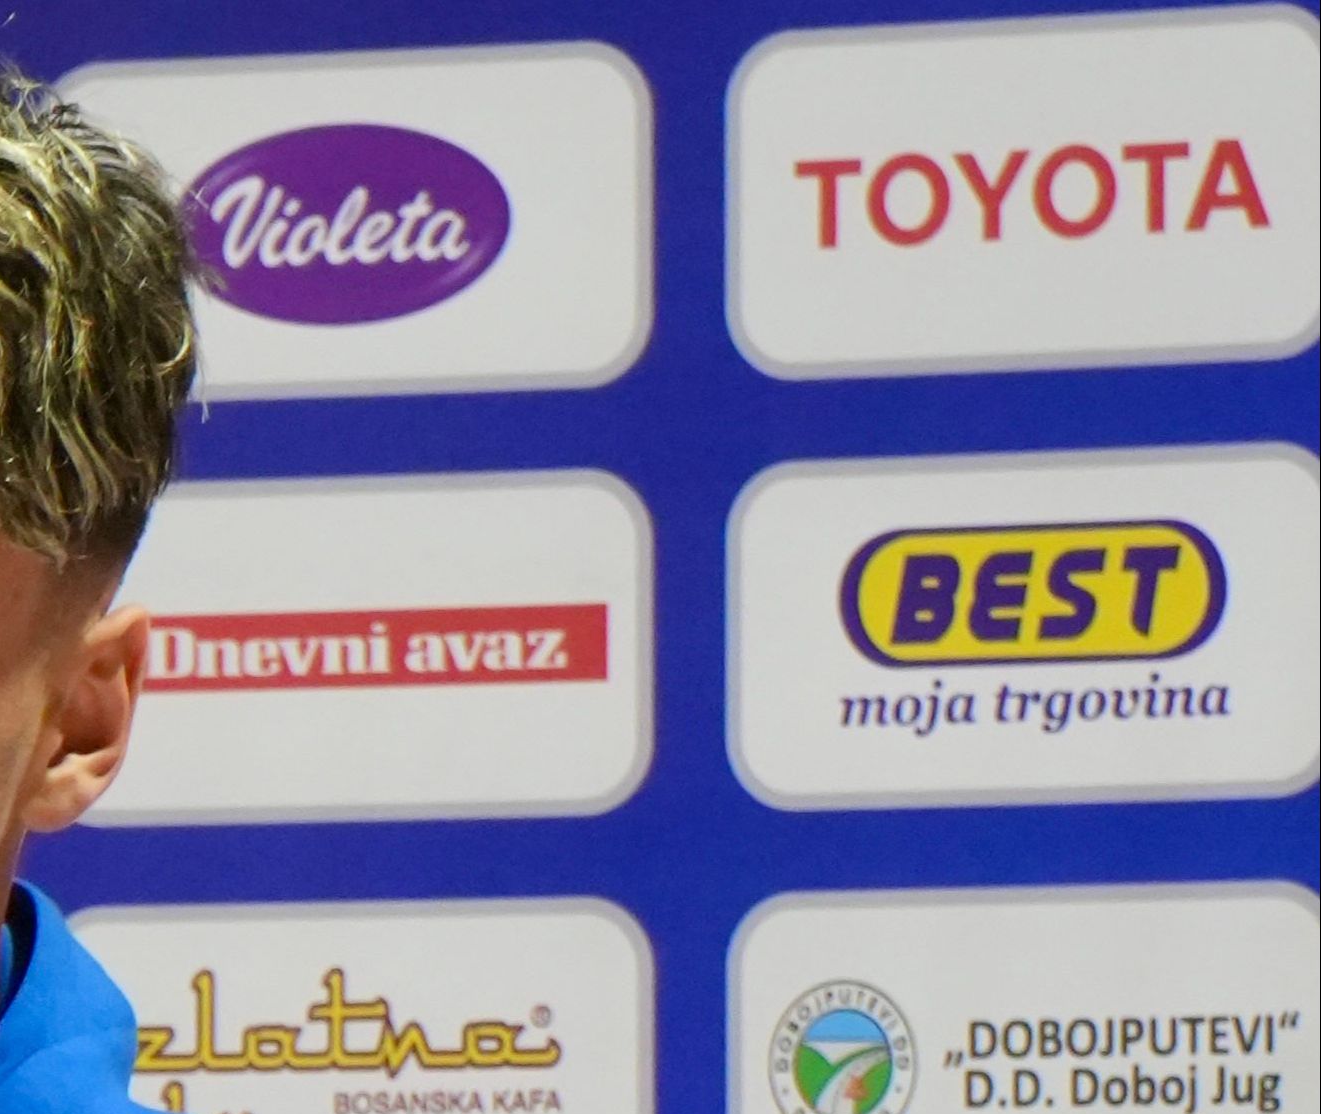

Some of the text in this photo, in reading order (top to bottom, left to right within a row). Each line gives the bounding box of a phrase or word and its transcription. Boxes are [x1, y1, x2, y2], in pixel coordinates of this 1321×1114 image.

[211, 175, 470, 269] Violeta
[794, 138, 1272, 249] TOYOTA
[889, 543, 1182, 645] BEST
[147, 622, 569, 679] Dnevni avaz
[839, 672, 1231, 737] moja trgovina
[492, 1089, 562, 1114] KAFA
[963, 1066, 1282, 1114] D.D. Doboj Jug
